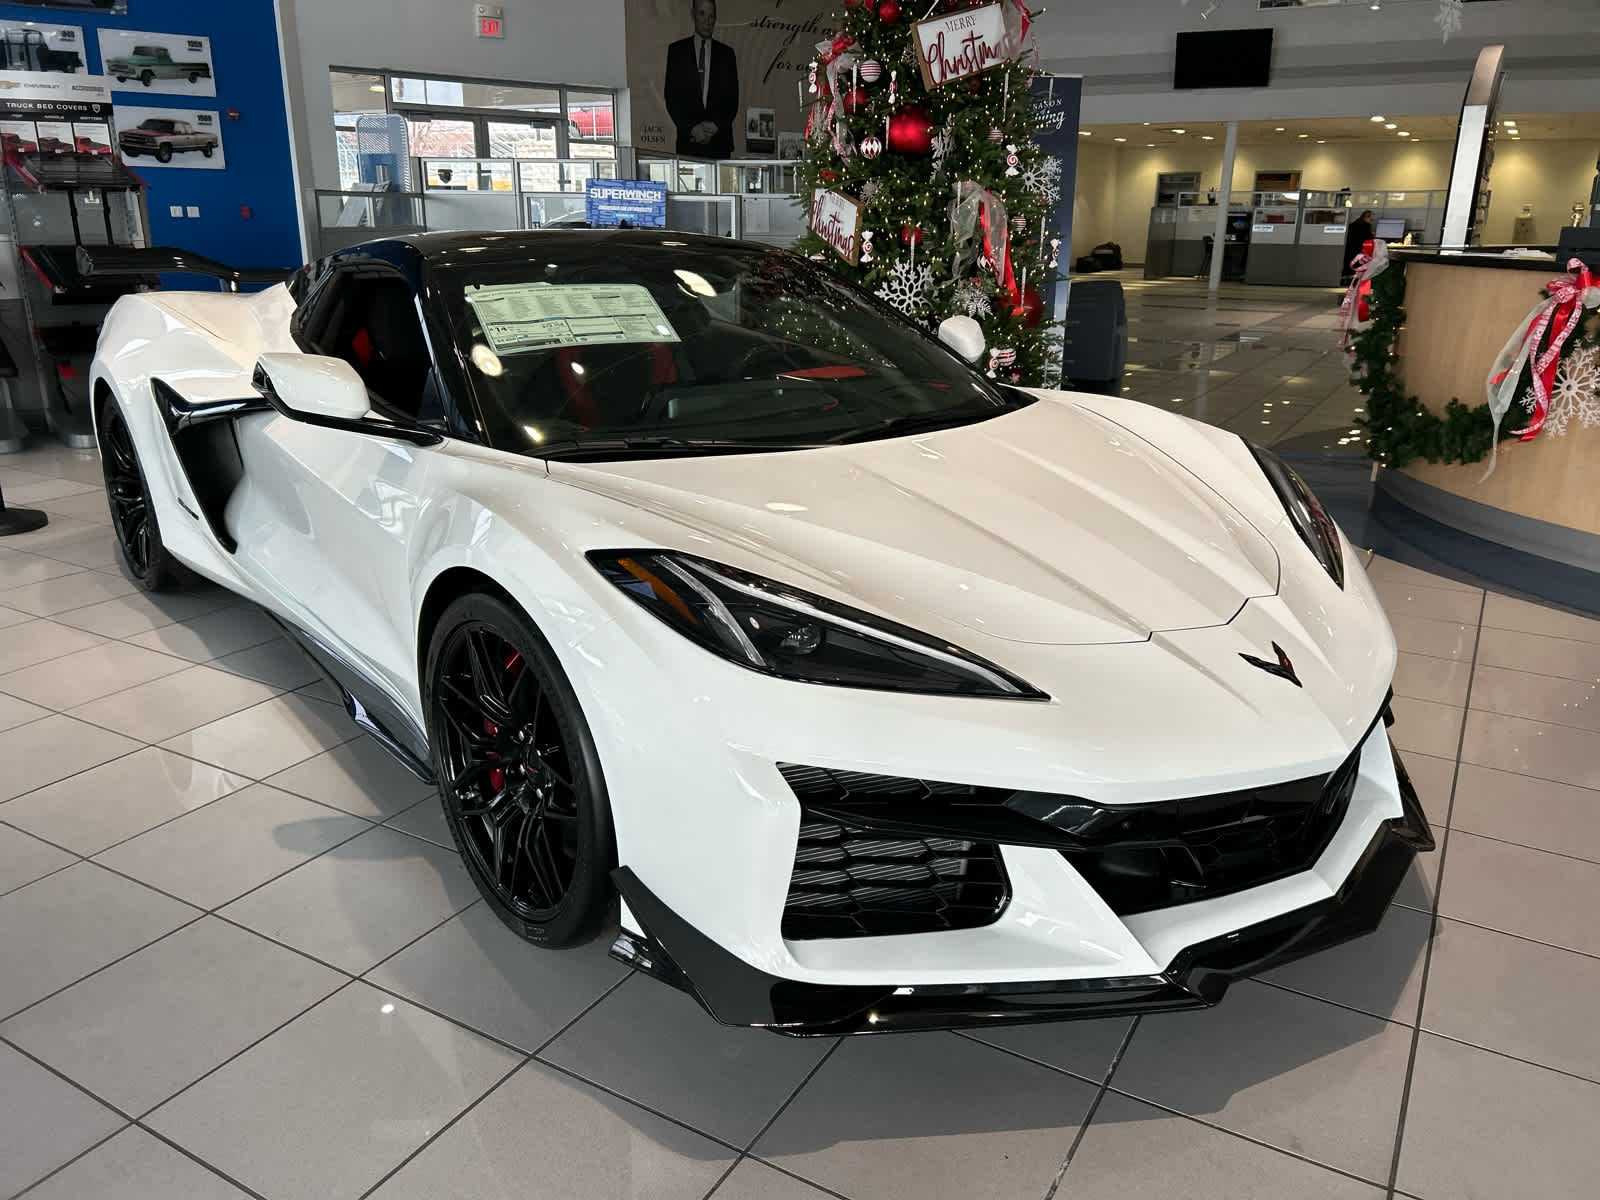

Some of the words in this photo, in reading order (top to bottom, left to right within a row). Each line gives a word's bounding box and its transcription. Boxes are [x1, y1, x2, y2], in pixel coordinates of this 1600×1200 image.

[481, 19, 501, 36] EXIT
[749, 13, 823, 46] strength
[945, 15, 976, 32] MERRY
[763, 48, 792, 84] for
[590, 188, 661, 202] SUPERWINCH
